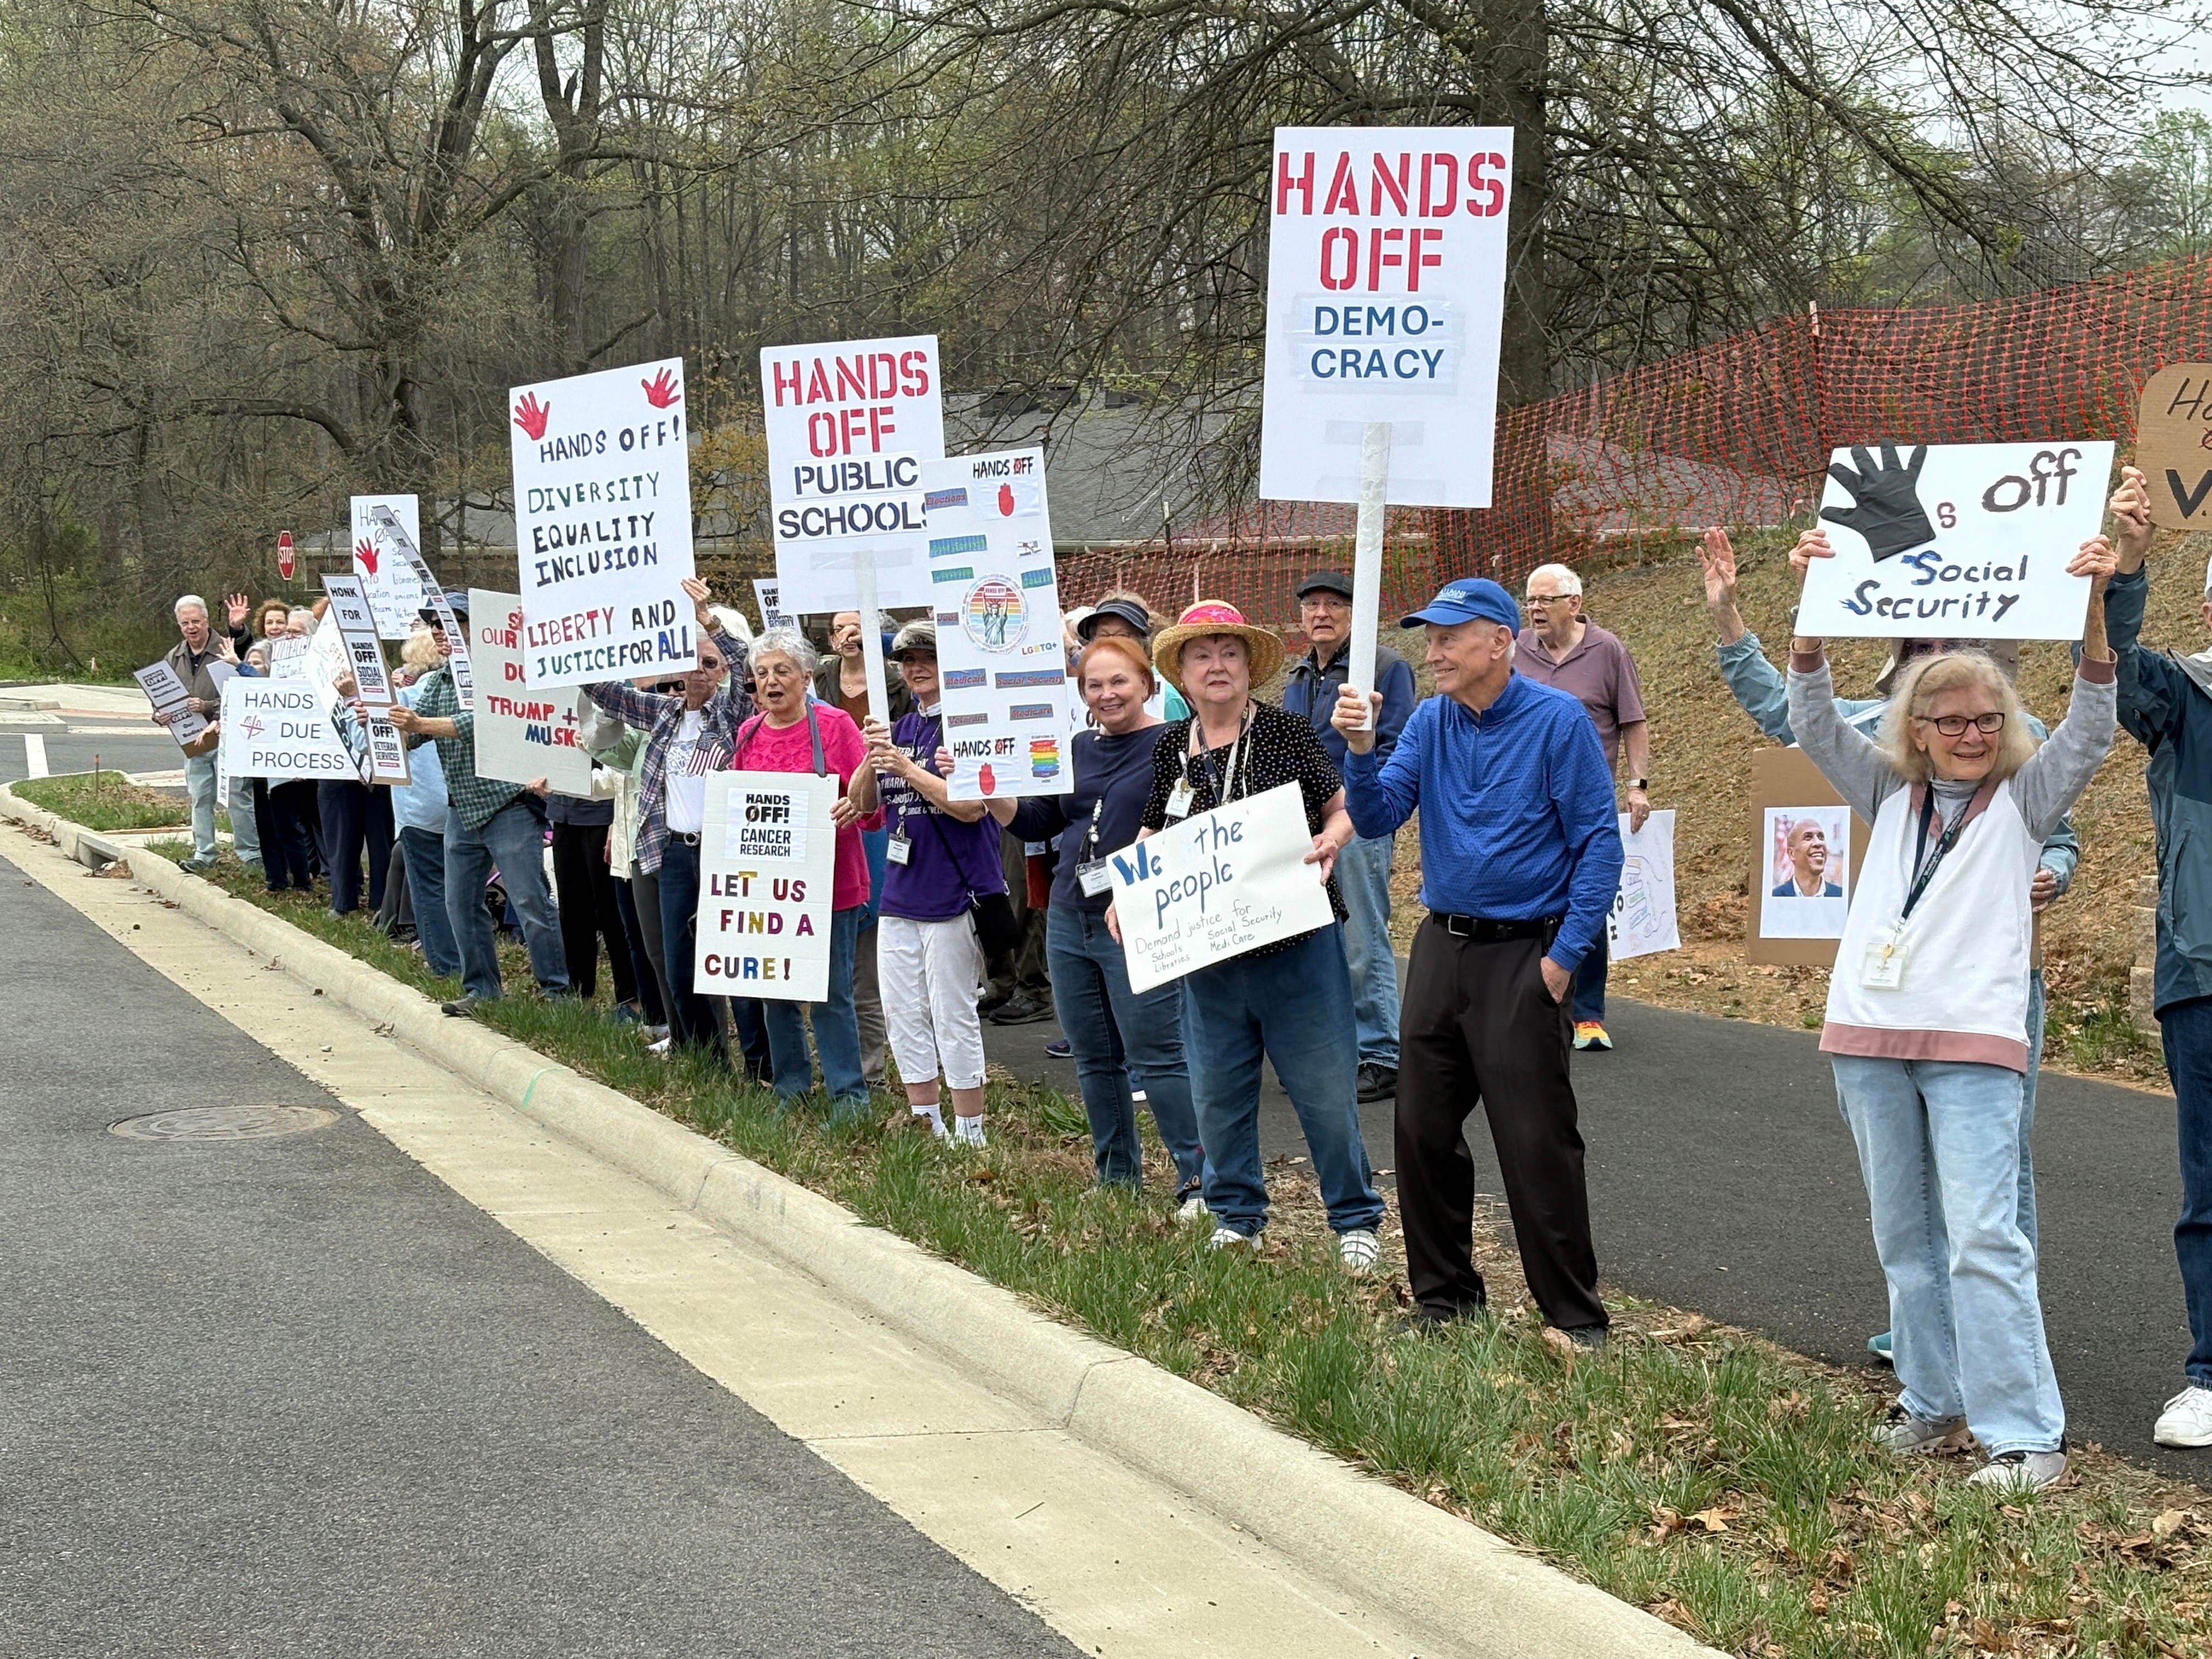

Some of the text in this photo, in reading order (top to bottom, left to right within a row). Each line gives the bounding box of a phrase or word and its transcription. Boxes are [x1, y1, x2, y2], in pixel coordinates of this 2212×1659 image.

[1276, 151, 1506, 217] HANDS
[1320, 226, 1443, 292] OFF
[1314, 305, 1444, 336] DEMO-
[1311, 348, 1444, 379] CRACY
[773, 350, 929, 407] HANDS
[540, 414, 680, 463] HANDS OFF!
[808, 406, 895, 458] OFF
[794, 456, 919, 495] PUBLIC
[973, 456, 1034, 479] HANDS OFF
[528, 471, 660, 514] DIVERSITY
[532, 512, 655, 554] EQUALITY
[279, 546, 293, 564] STOP
[535, 542, 658, 587] INCLUSION
[1901, 550, 2028, 586] Social
[330, 587, 359, 598] HONK
[1840, 580, 2020, 623] Security
[341, 609, 362, 620] FOR
[527, 606, 615, 648] LIBERTY
[632, 599, 676, 631] AND
[481, 627, 517, 649] OUR
[658, 625, 696, 662] ALL
[1021, 642, 1057, 655] LGBTQ+
[355, 651, 378, 663] OFF!
[146, 673, 167, 686] OFF!
[357, 666, 383, 678] SOCIAL
[946, 674, 986, 685] Medicaid
[996, 674, 1063, 686] Social Security
[245, 693, 314, 709] HANDS
[486, 695, 555, 721] TRUMP
[1012, 707, 1053, 717] Medicare
[281, 722, 321, 739] DUE
[950, 715, 987, 724] Veterans
[373, 725, 394, 738] OFF!
[525, 724, 576, 747] MUSK
[373, 741, 398, 751] VETERAN
[375, 751, 400, 761] SERVICES
[953, 737, 1016, 758] HANDS OFF
[252, 751, 345, 770] PROCESS
[745, 793, 791, 806] HANDS
[745, 805, 791, 824] OFF!
[741, 828, 791, 845] CANCER
[740, 843, 791, 857] RESEARCH
[1112, 841, 1163, 886] We
[1194, 813, 1244, 854] the
[711, 871, 807, 902] LET US
[1155, 855, 1233, 930] people
[720, 909, 815, 937] FIND A
[1135, 899, 1252, 954] Demand justice for
[1151, 906, 1282, 963] Schools Social Security
[1155, 954, 1191, 973] Libraries
